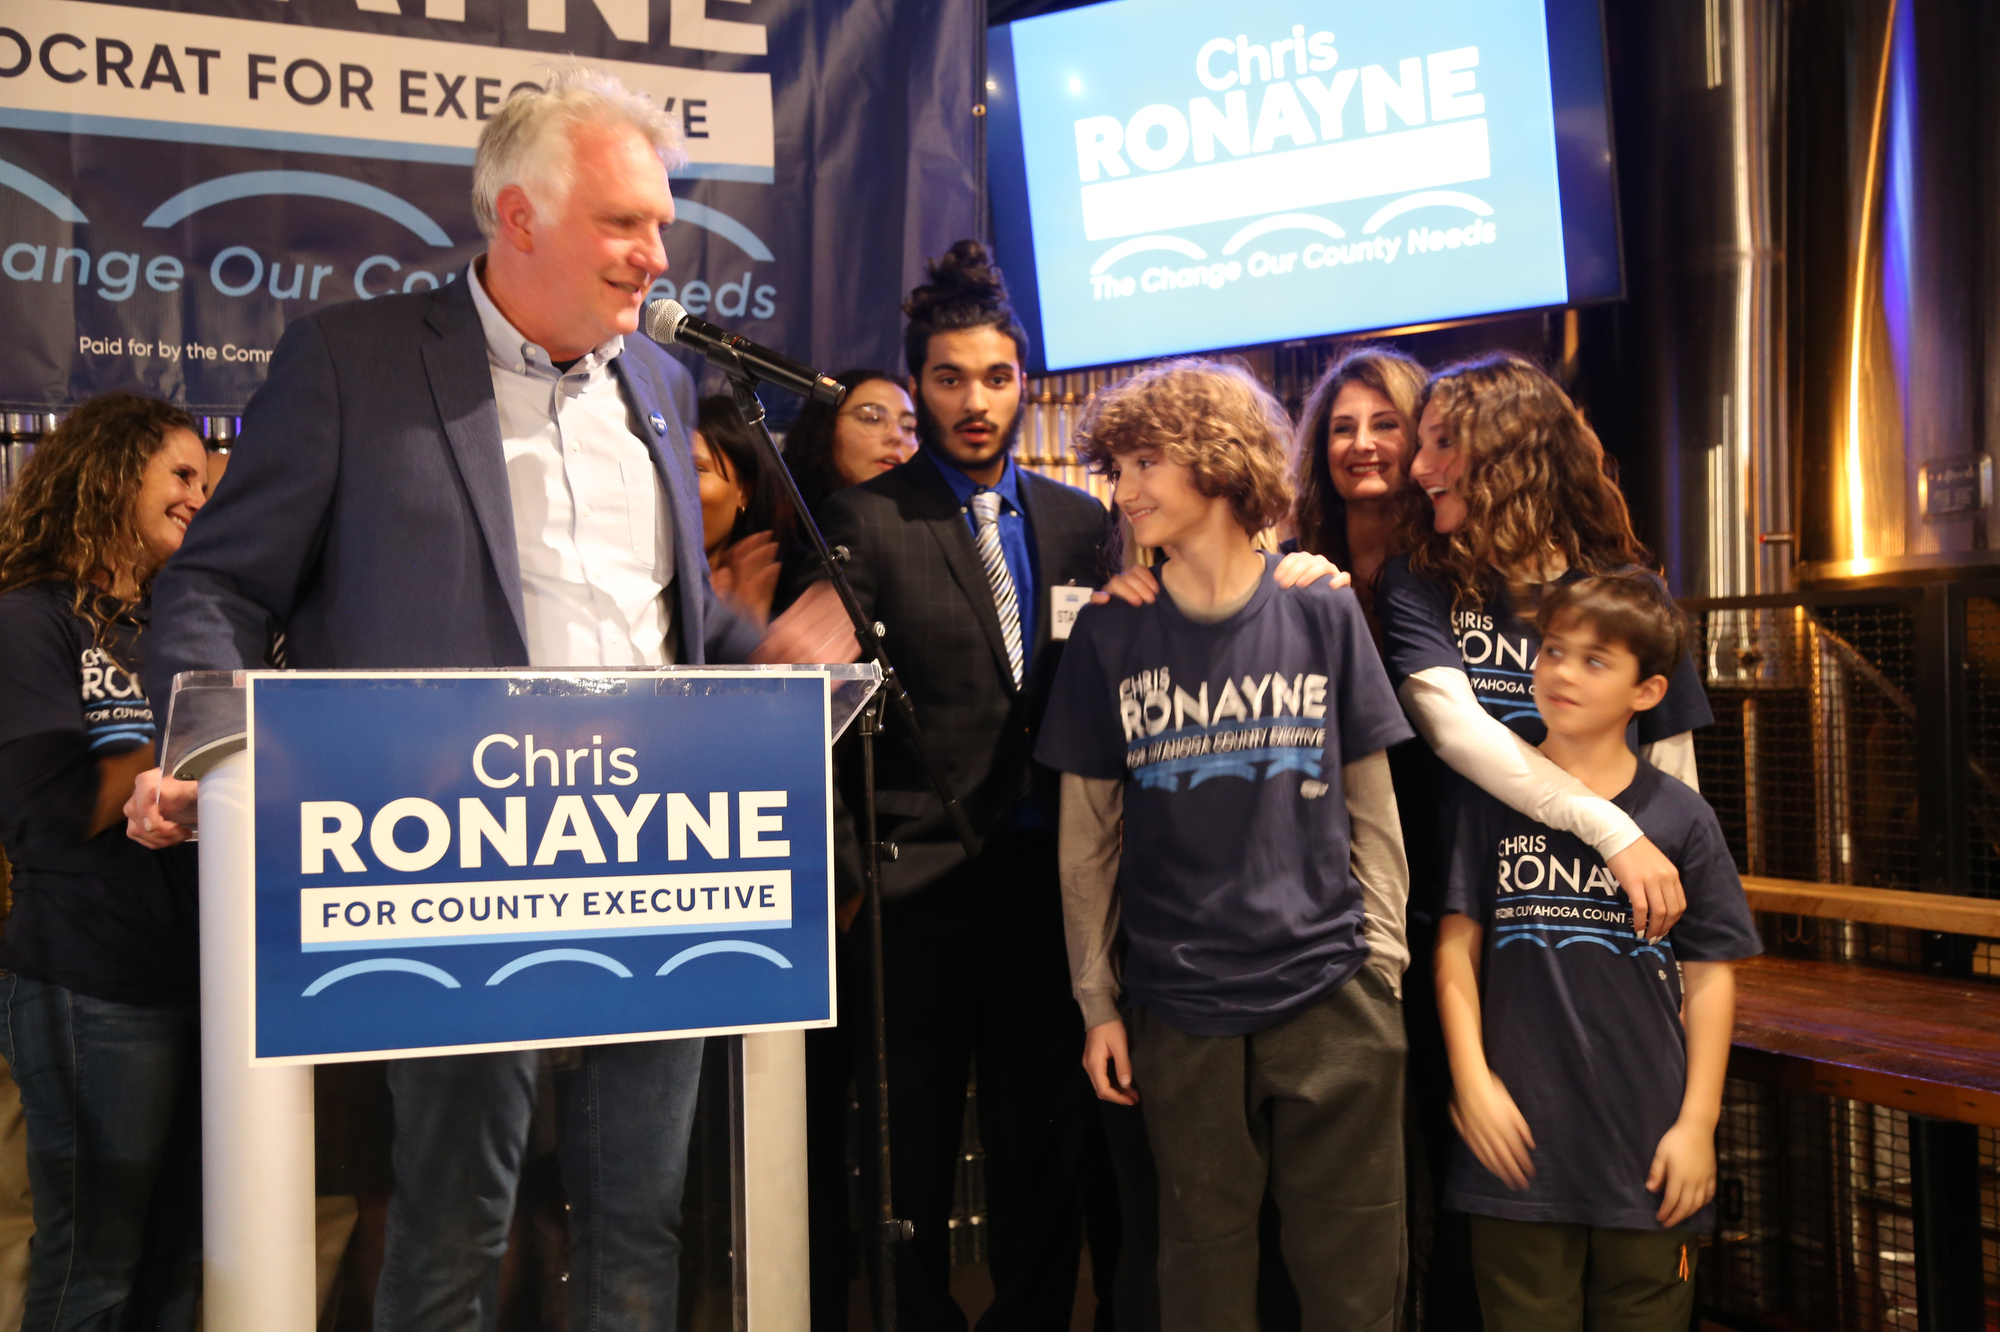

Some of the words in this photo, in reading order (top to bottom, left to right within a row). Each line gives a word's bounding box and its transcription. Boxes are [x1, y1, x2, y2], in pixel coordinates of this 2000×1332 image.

[248, 53, 374, 111] FOR
[1196, 24, 1338, 91] Chris
[1074, 45, 1486, 182] RONAYNE
[2, 242, 185, 301] ange
[210, 246, 333, 300] Our
[645, 271, 777, 319] eeds
[1090, 274, 1136, 300] The
[1140, 260, 1243, 293] Change
[1247, 250, 1298, 277] Our
[1302, 235, 1402, 269] County
[1407, 218, 1497, 255] Needs
[79, 336, 123, 355] Paid
[127, 338, 153, 356] for
[158, 340, 182, 362] by
[186, 342, 217, 360] the
[1120, 671, 1328, 743] RONAYNE
[472, 733, 639, 789] Chris
[301, 790, 791, 874] RONAYNE
[1498, 835, 1547, 857] CHRIS
[323, 901, 396, 928] FOR
[411, 893, 569, 924] COUNTY
[583, 885, 776, 916] EXECUTIVE
[1516, 905, 1580, 918] CUYAHOGA
[1583, 908, 1627, 924] COUNT
